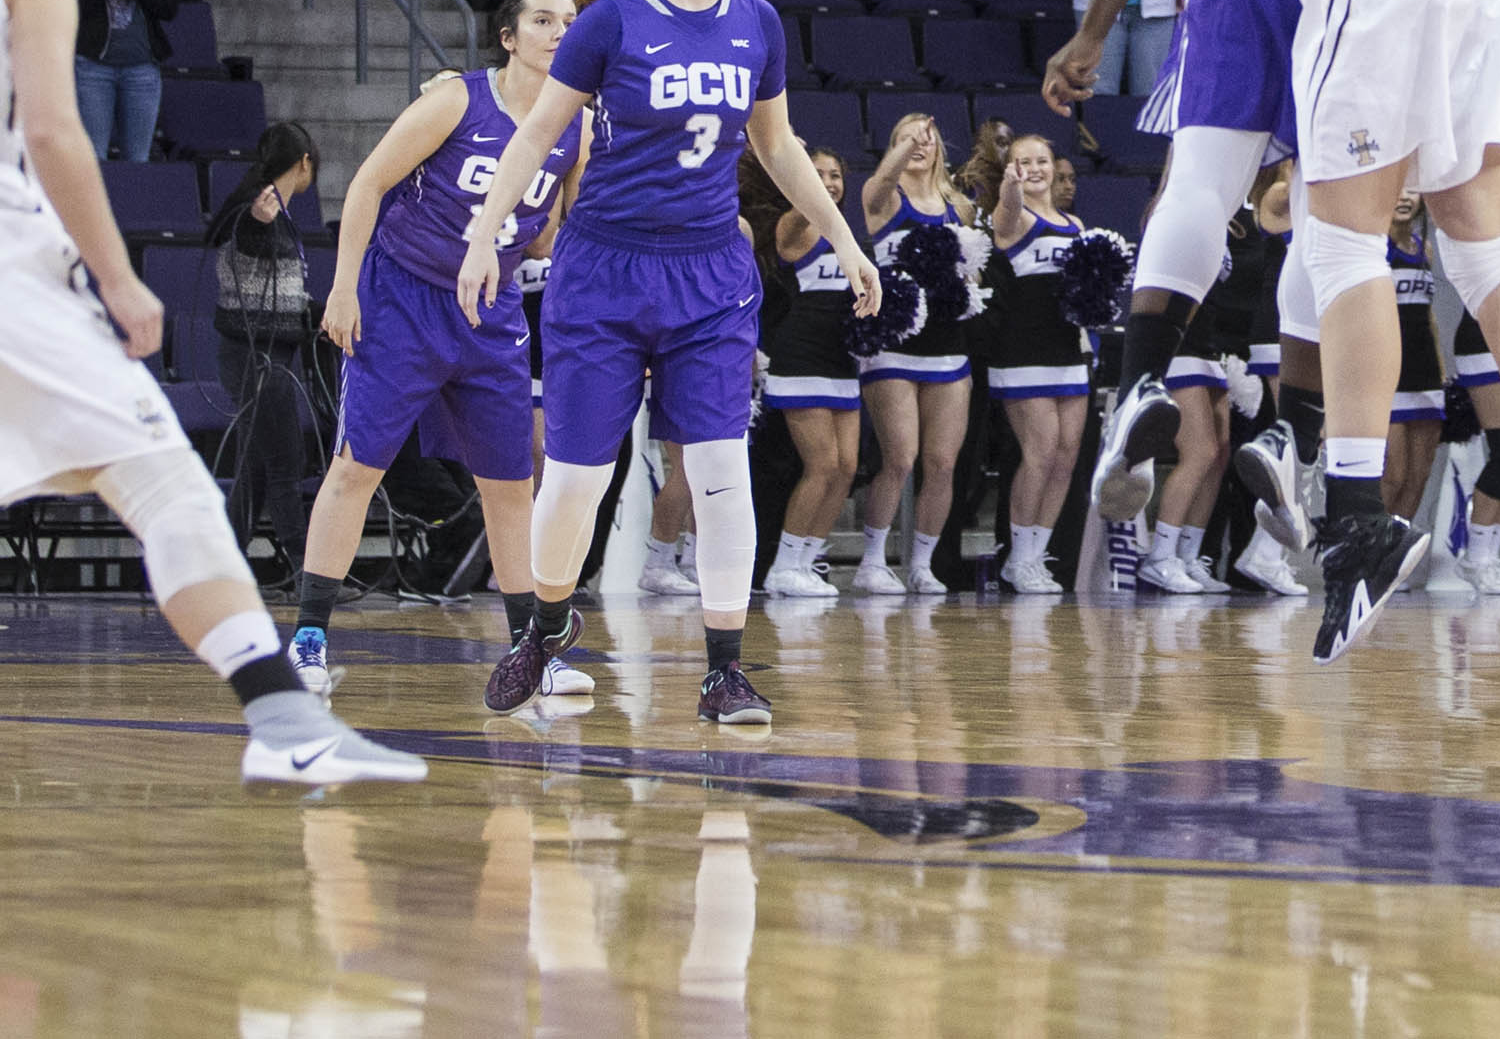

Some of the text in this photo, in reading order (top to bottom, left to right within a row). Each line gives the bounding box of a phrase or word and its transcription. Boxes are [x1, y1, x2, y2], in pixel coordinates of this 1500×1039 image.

[649, 62, 752, 111] GCU
[677, 113, 722, 169] 3
[456, 154, 558, 209] GU
